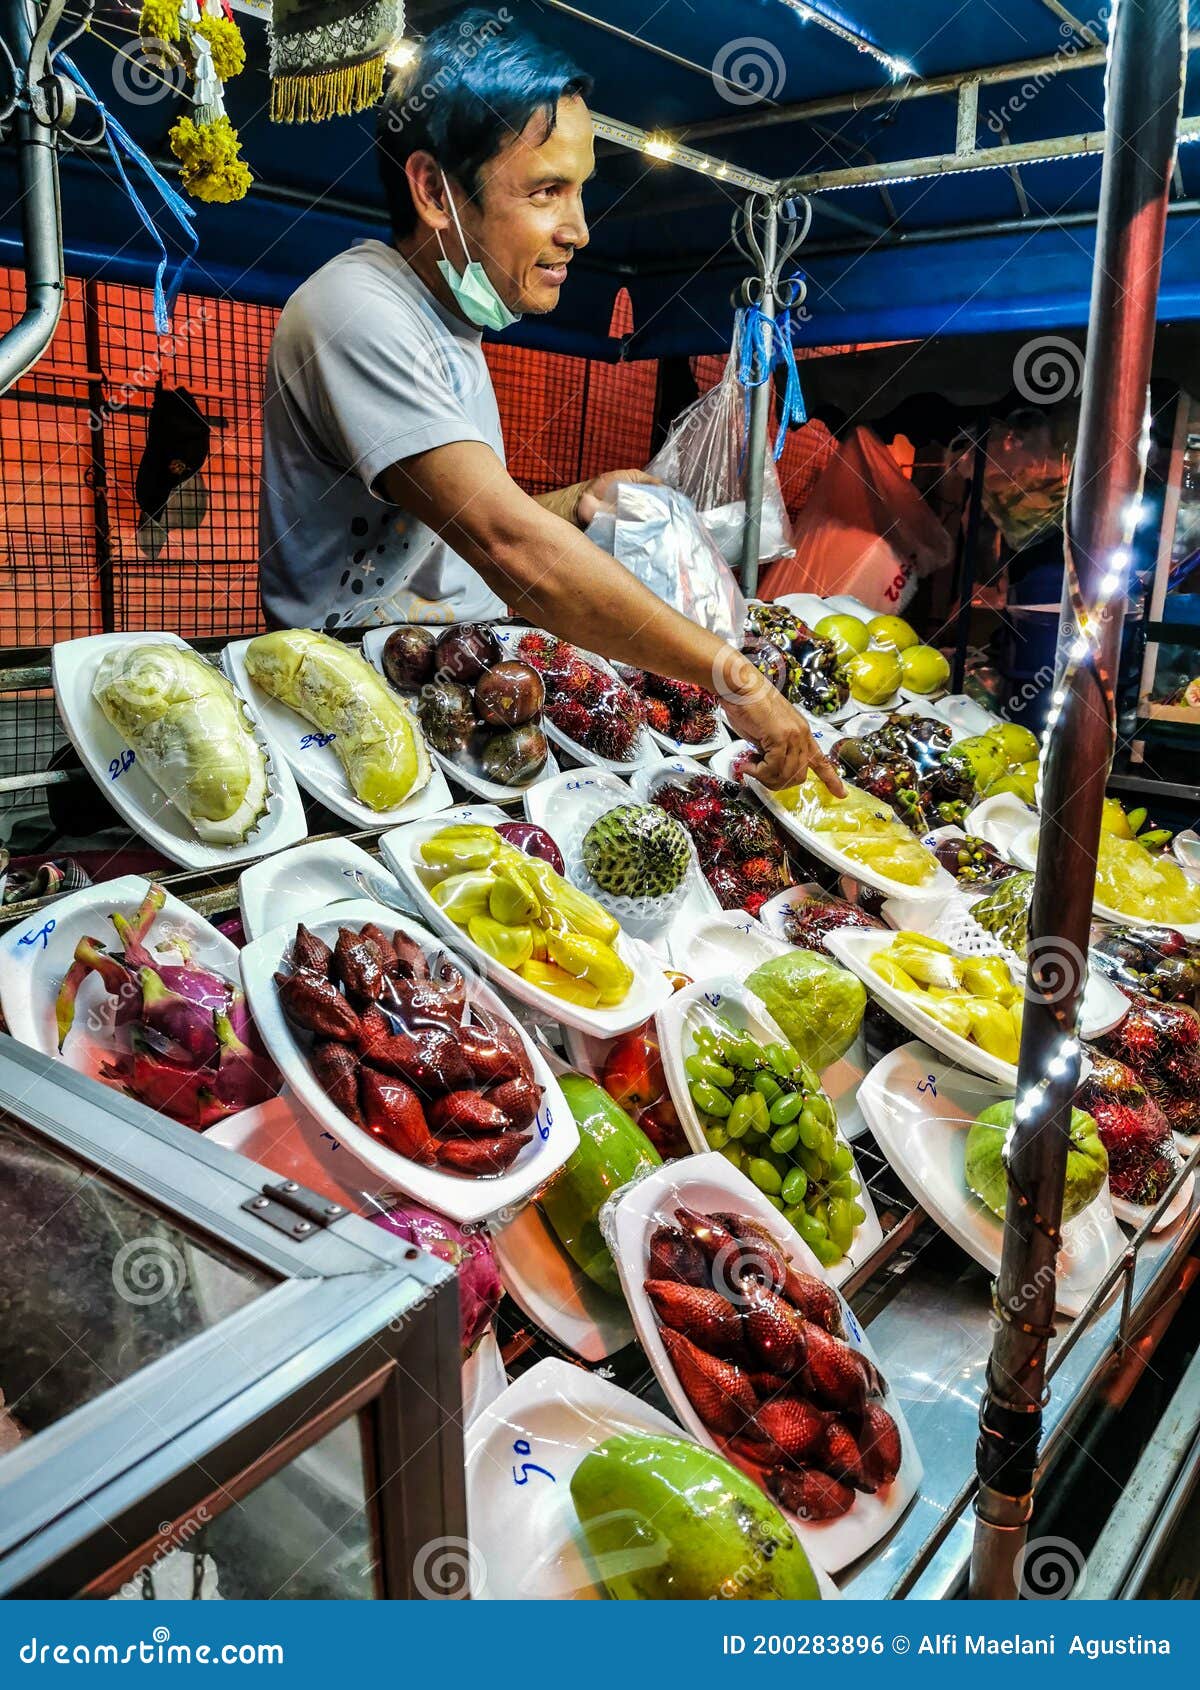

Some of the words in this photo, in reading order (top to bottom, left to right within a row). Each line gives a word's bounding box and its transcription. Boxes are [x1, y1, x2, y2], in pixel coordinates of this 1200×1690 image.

[300, 732, 337, 750] 280
[916, 1074, 938, 1098] 50
[535, 1107, 553, 1140] 60
[513, 1439, 556, 1486] 50
